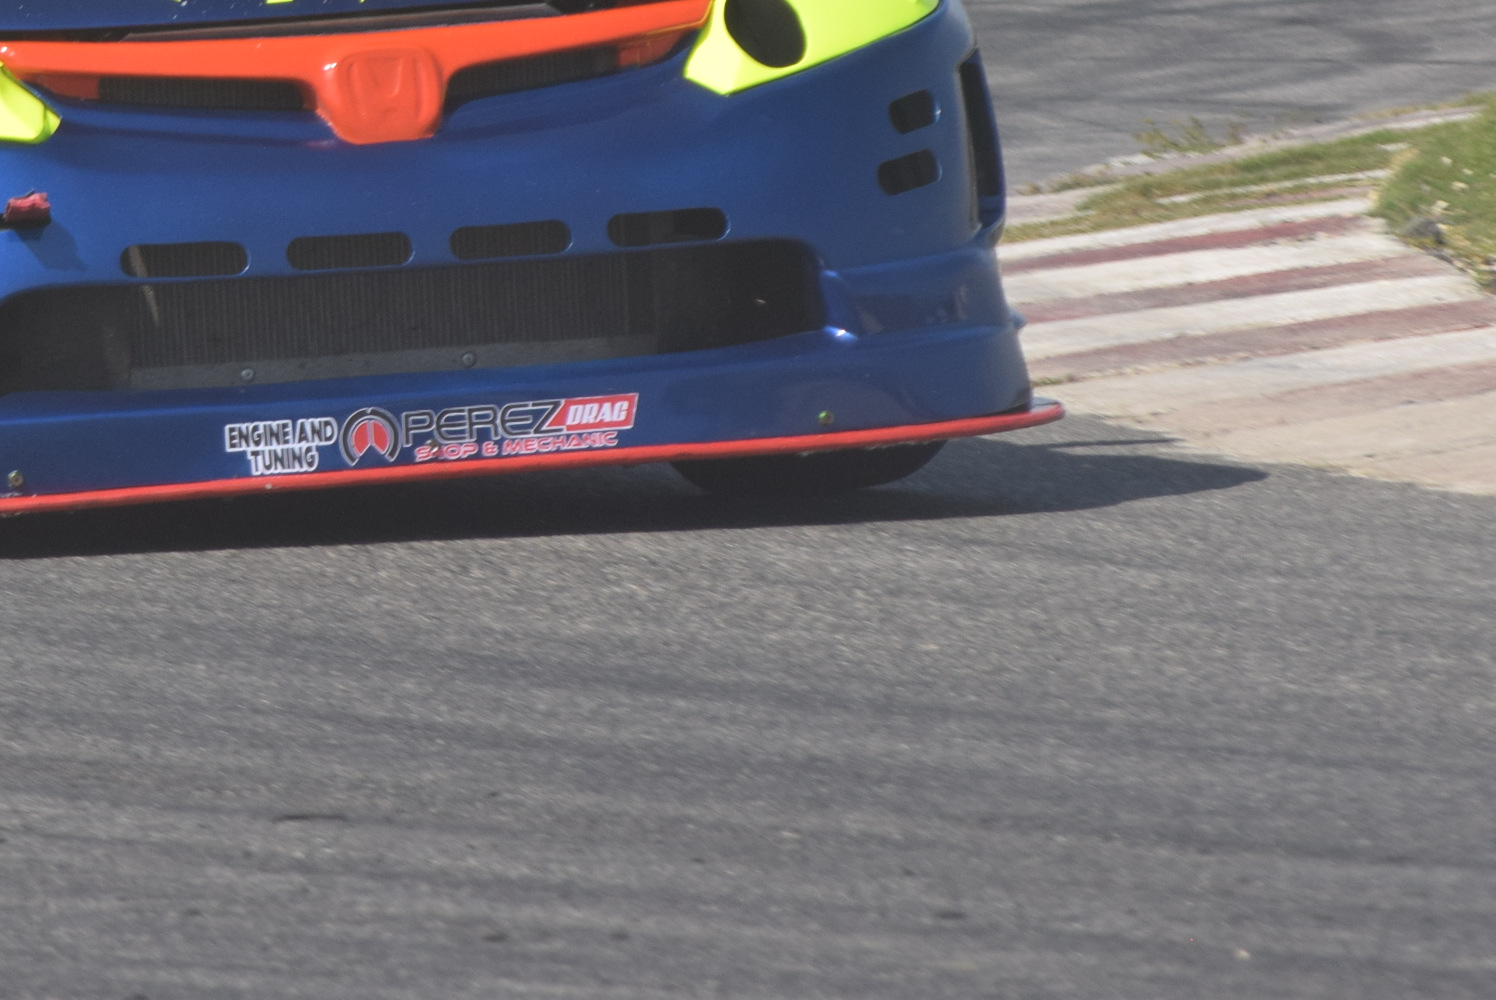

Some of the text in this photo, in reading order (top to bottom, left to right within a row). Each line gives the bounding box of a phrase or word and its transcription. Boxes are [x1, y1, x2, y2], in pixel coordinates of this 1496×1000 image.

[226, 418, 337, 451] ENGINE AND
[403, 400, 629, 448] PEREZ DRAG
[482, 441, 498, 457] &
[502, 431, 618, 456] MECHANIC
[248, 445, 319, 475] TUNING
